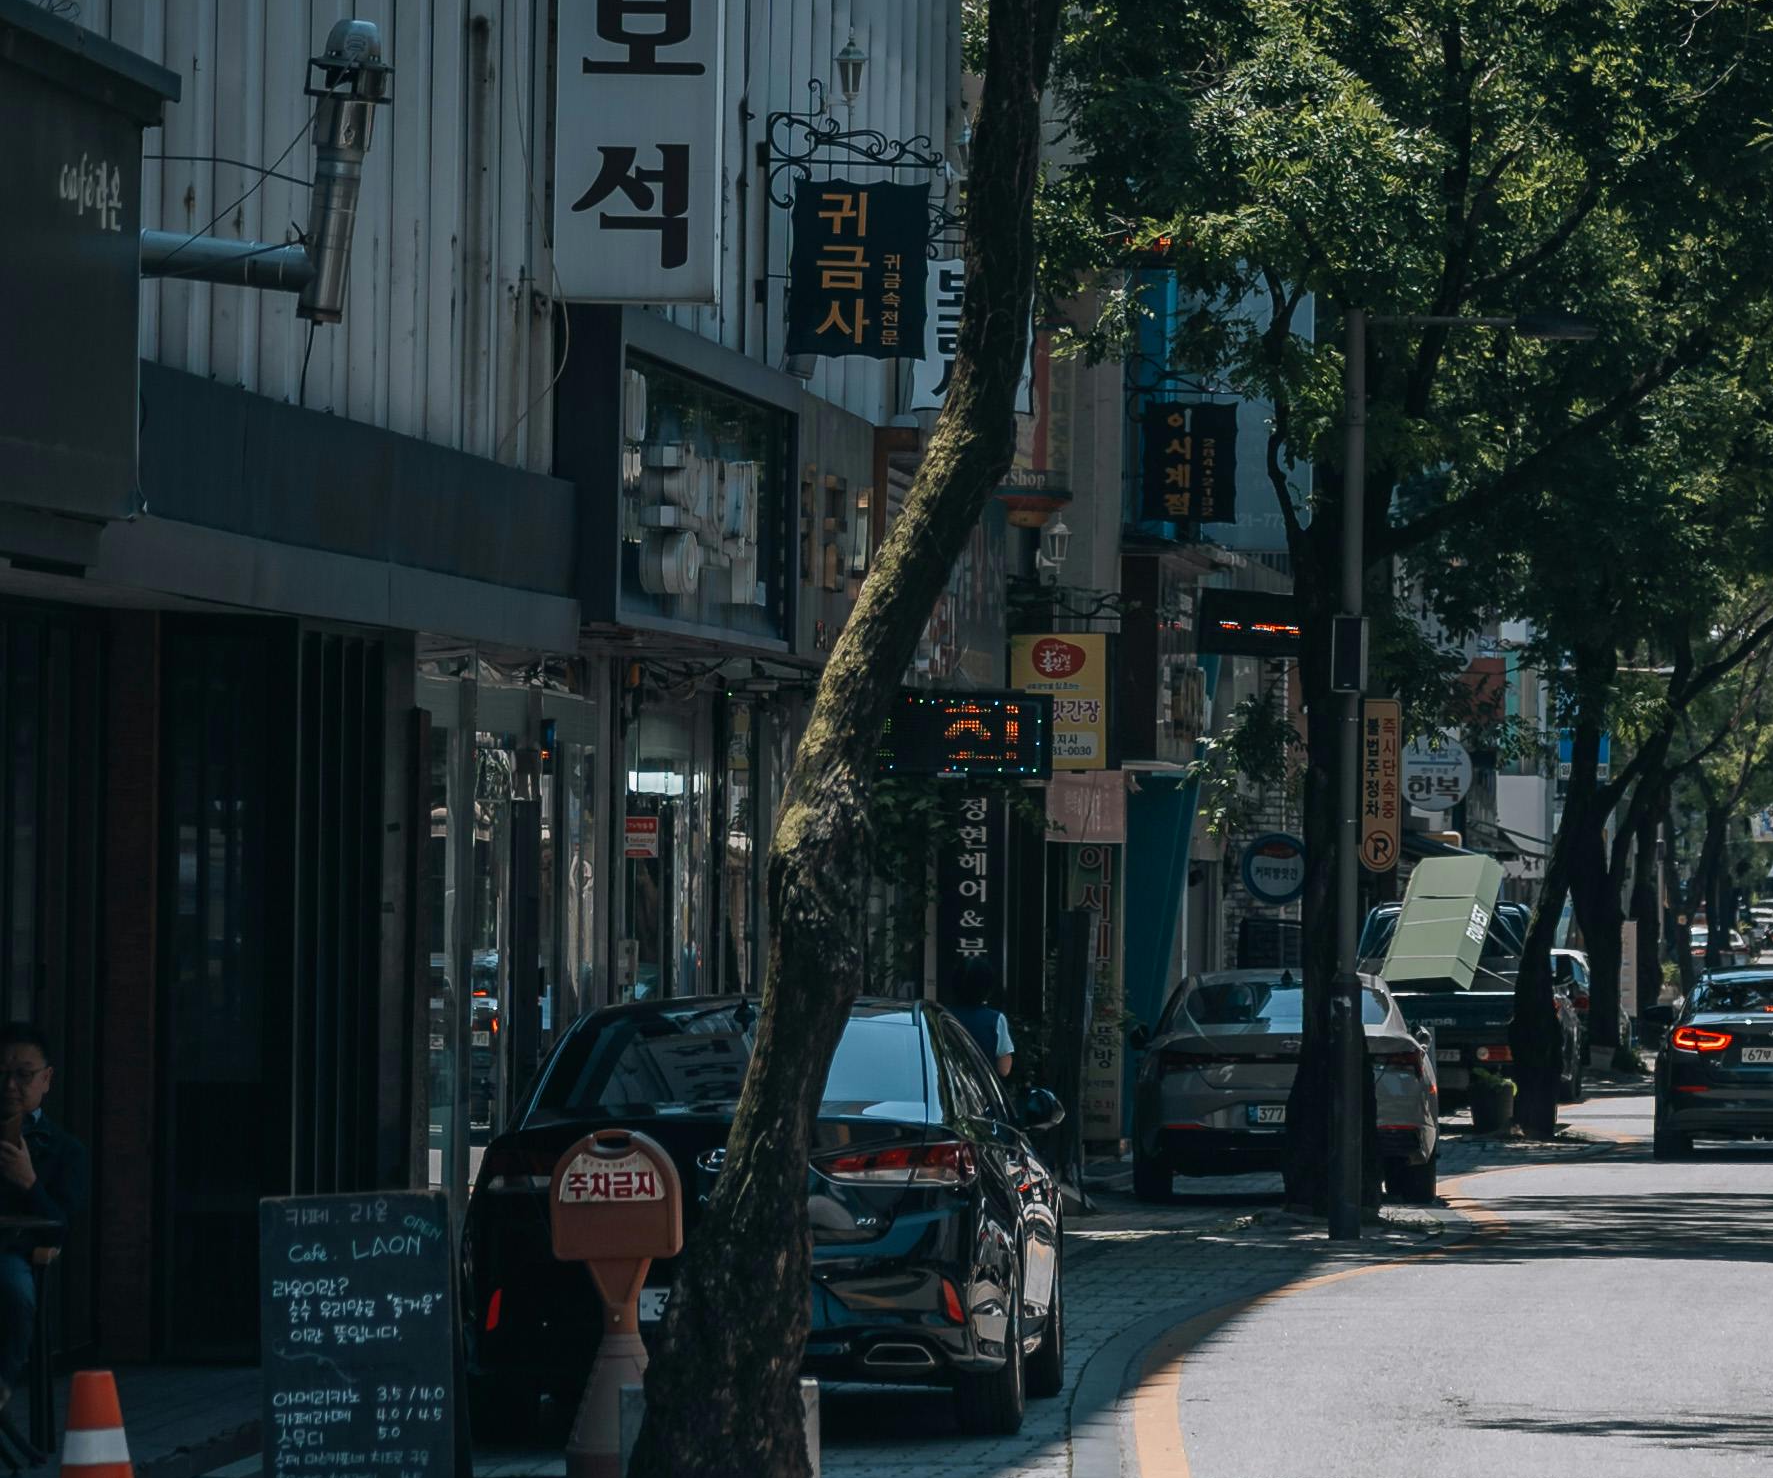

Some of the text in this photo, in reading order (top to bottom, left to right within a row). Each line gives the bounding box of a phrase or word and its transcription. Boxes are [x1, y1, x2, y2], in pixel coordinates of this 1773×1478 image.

[815, 191, 871, 345] 귀금사
[880, 254, 902, 346] 귀금속전문
[1164, 408, 1193, 516] 이시계점
[1366, 718, 1379, 819] 불법주정차
[1382, 718, 1396, 819] 즉시단속중
[1408, 776, 1461, 802] 한복
[568, 1171, 655, 1199] 주차금지
